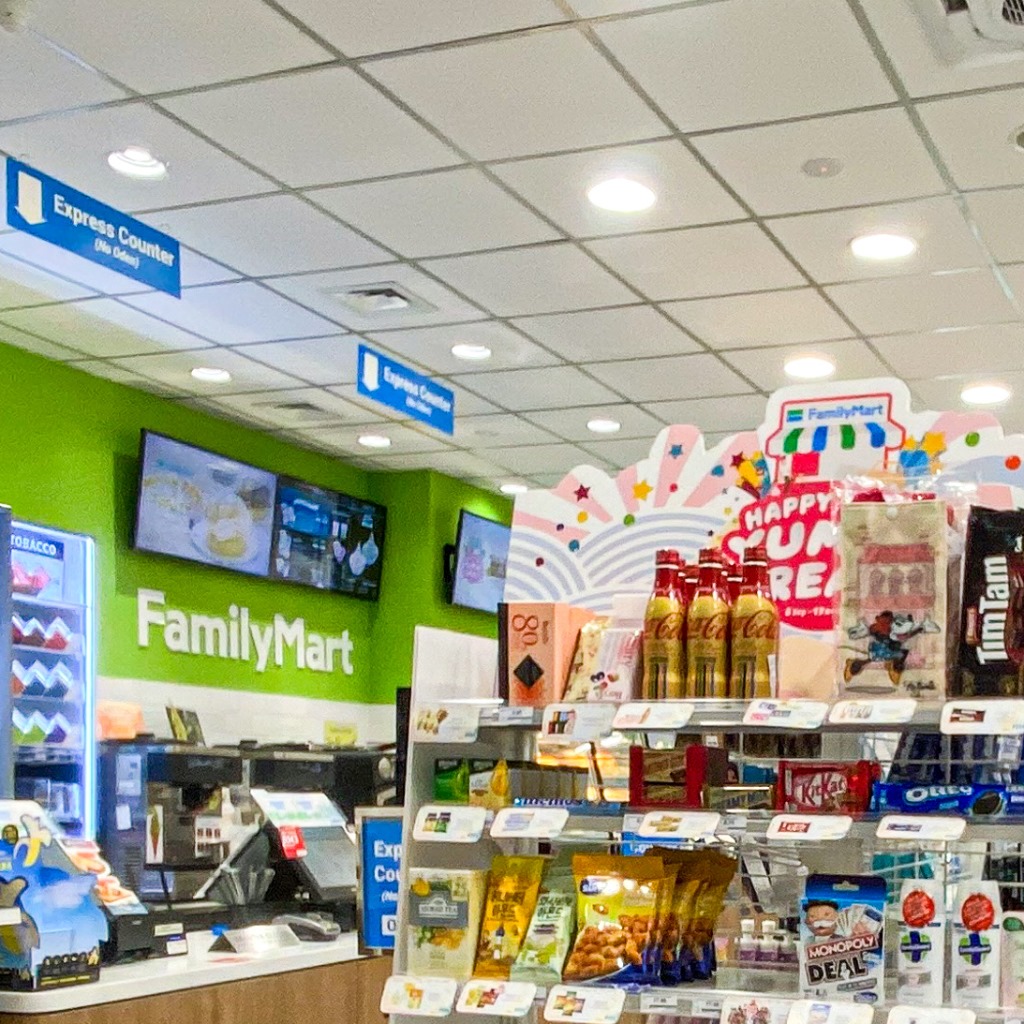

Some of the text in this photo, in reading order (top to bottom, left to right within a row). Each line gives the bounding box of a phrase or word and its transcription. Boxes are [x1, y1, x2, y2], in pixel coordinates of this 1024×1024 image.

[54, 193, 174, 267] Express Counter
[808, 404, 883, 420] FamilyMart
[744, 492, 834, 531] HAPPY
[136, 588, 353, 675] FamilyMart
[808, 936, 875, 958] MONOPOLY
[807, 956, 868, 983] DEAL
